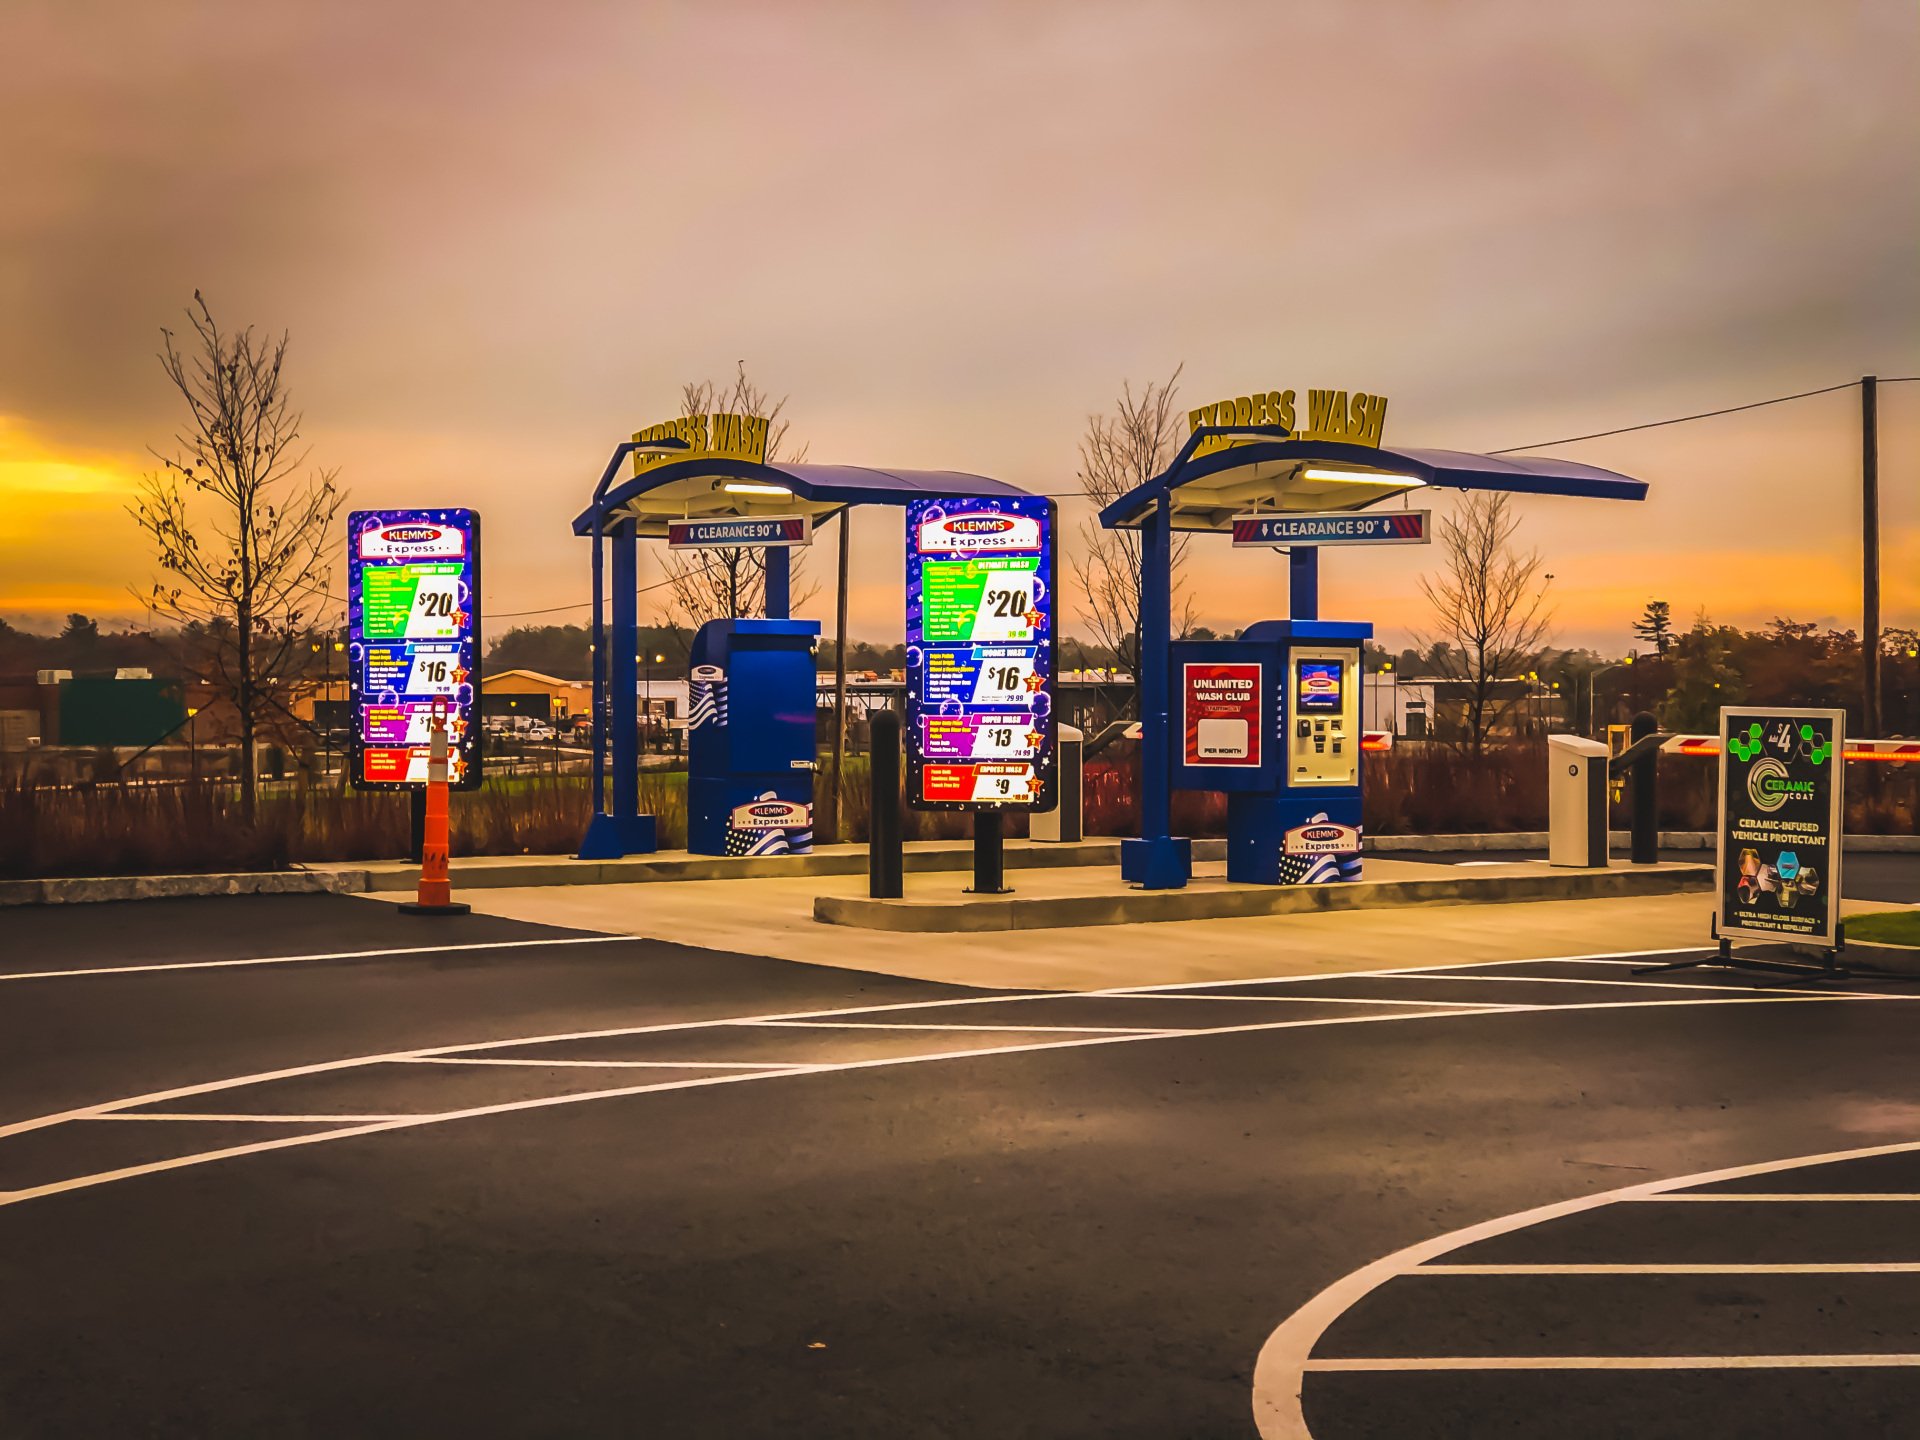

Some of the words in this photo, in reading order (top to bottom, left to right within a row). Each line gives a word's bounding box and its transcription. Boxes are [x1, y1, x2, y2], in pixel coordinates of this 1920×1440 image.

[1308, 389, 1388, 438] WASH
[712, 414, 769, 456] WASH
[698, 526, 755, 538] CLEARANCE
[953, 521, 1005, 532] KLEMM'S
[1274, 521, 1353, 536] CLEARANCE
[389, 530, 434, 540] KLEMM'S
[950, 537, 1007, 547] Express
[387, 545, 435, 554] Express
[418, 592, 453, 617] $20
[987, 590, 1027, 618] $20
[419, 661, 447, 683] $16
[988, 666, 1020, 691] $16
[1193, 679, 1253, 689] UNLIMITED
[1196, 692, 1223, 701] WASH
[1225, 692, 1251, 701] CLUB
[988, 728, 1012, 747] $13
[995, 778, 1010, 795] $9
[1765, 779, 1815, 792] CERAMIC
[1789, 793, 1814, 801] COAT
[754, 807, 788, 815] KLEMM'S
[1739, 819, 1819, 832] CERAMIC-INFUSED
[1306, 831, 1339, 839] KLEMM'S
[1732, 830, 1768, 842] VEHICLE
[1770, 834, 1826, 846] PROTECTANT
[1305, 843, 1340, 851] Express
